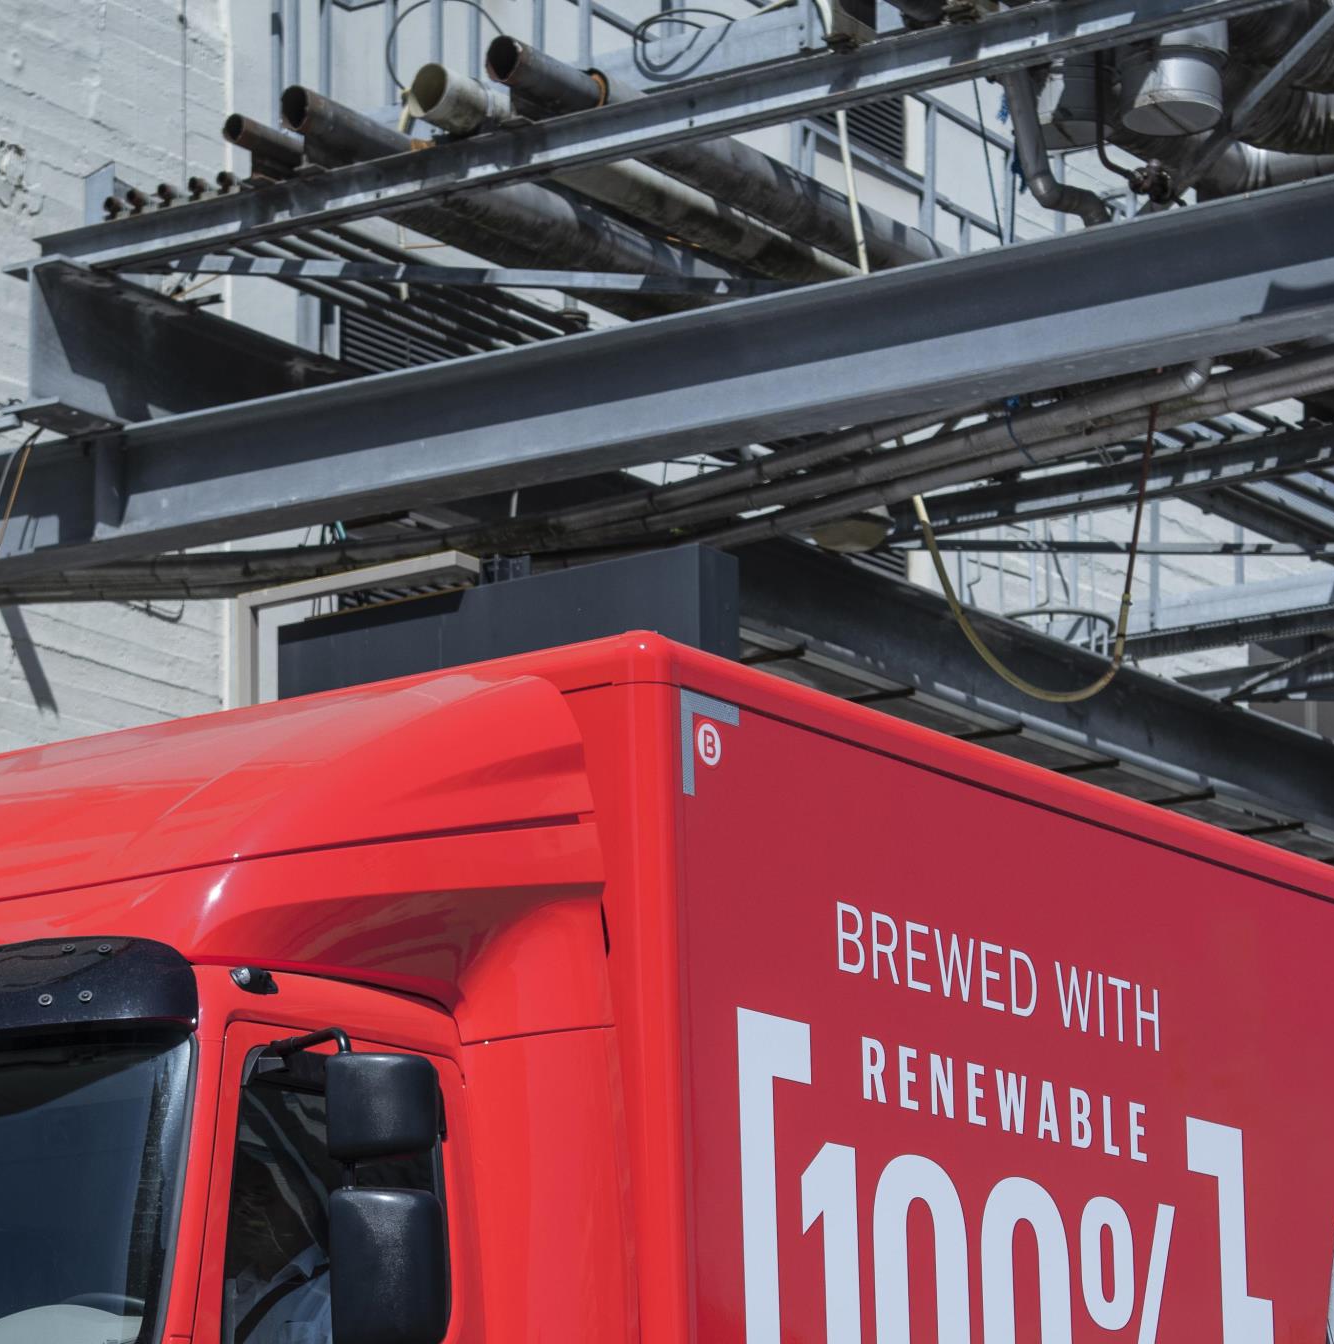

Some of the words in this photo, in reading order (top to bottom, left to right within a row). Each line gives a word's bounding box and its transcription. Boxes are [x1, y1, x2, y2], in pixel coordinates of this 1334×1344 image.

[835, 900, 1038, 1018] BREWED
[1053, 960, 1163, 1052] WITH
[860, 1035, 1149, 1163] RENEWABLE
